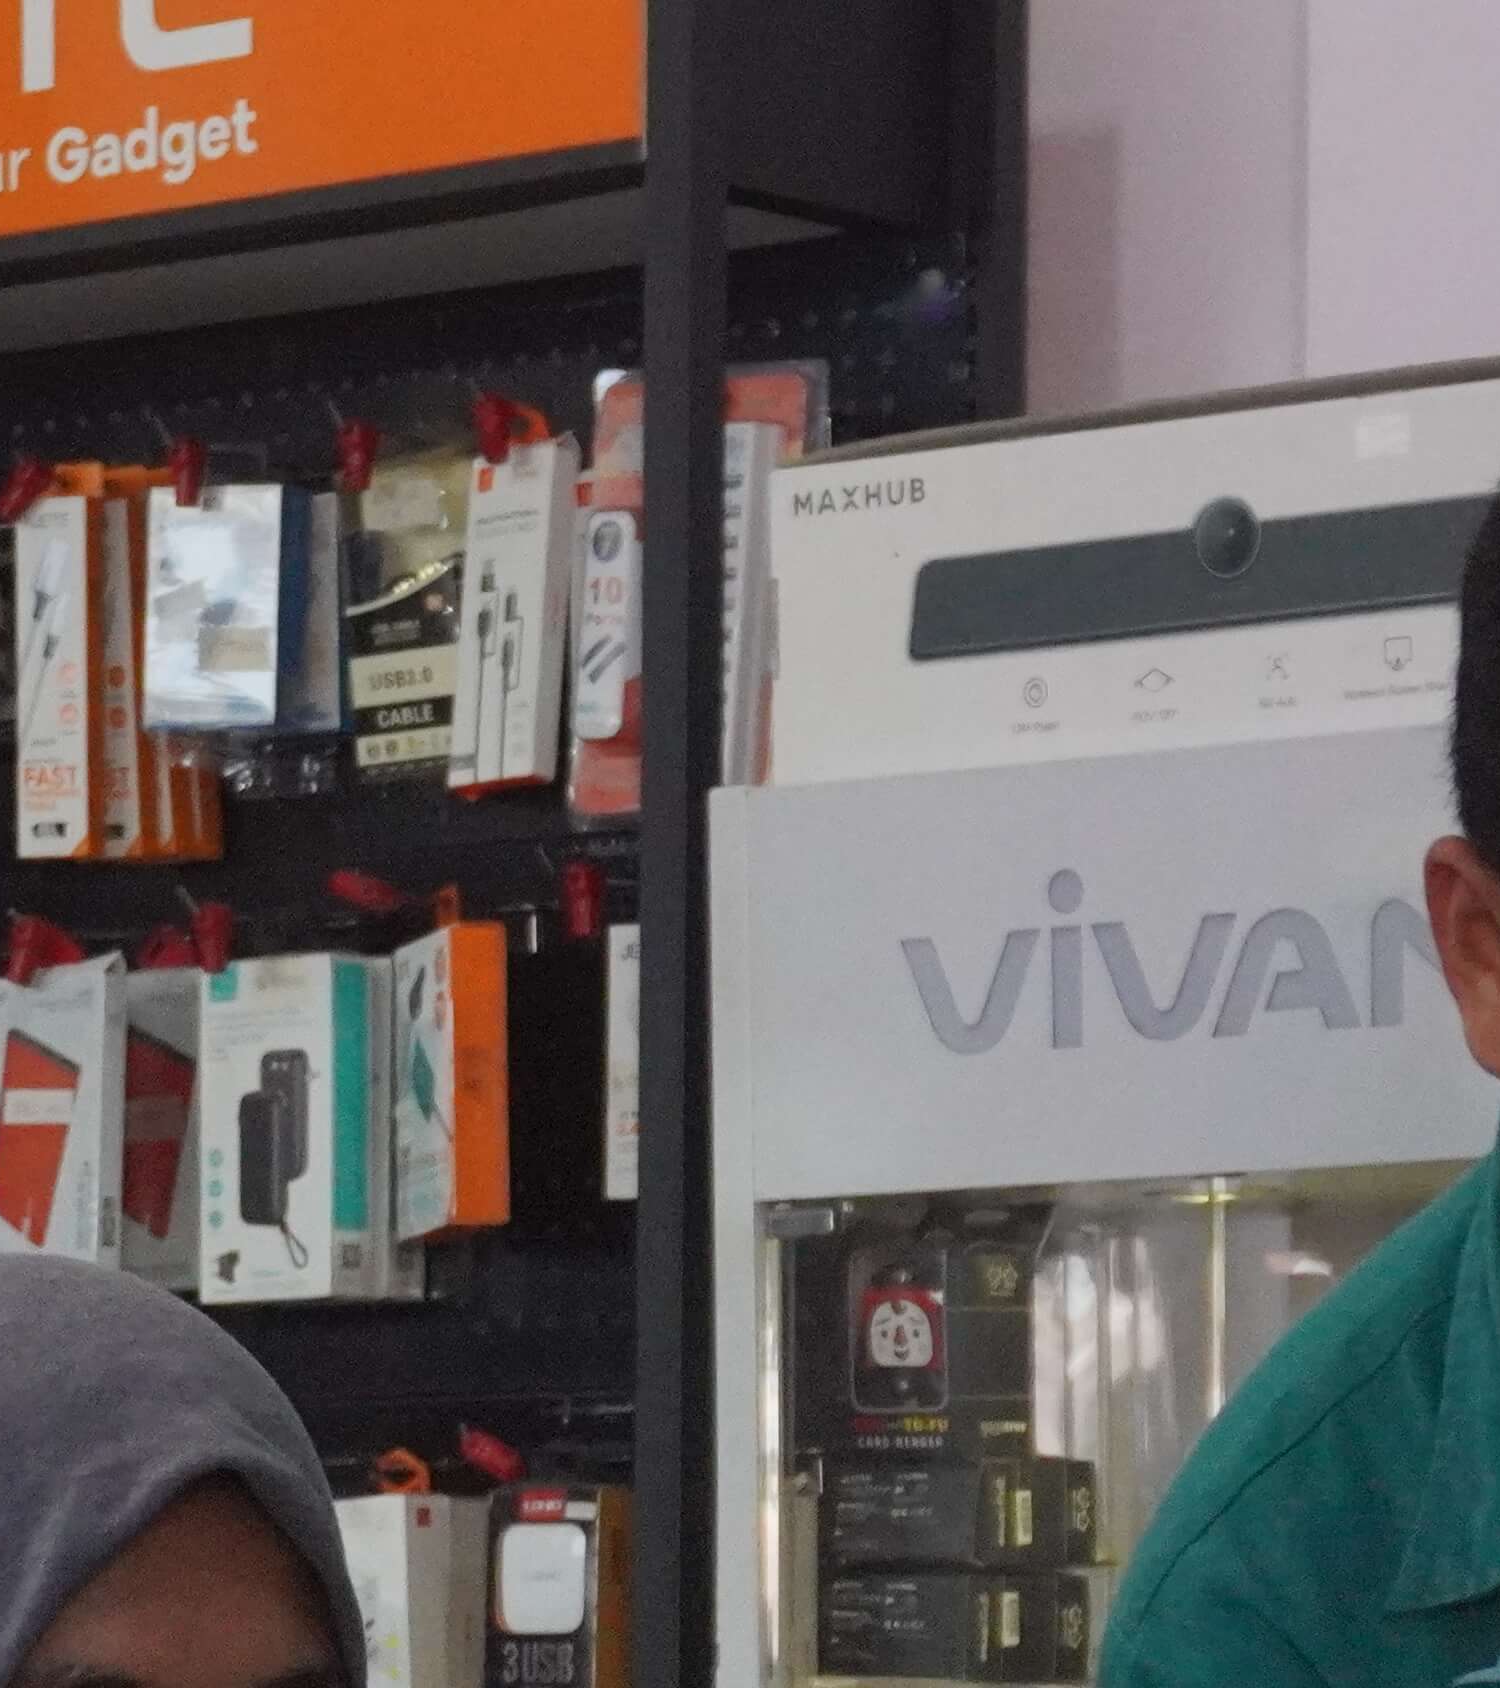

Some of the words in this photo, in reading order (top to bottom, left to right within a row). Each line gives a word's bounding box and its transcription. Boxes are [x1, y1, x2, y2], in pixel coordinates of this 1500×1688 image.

[46, 98, 258, 184] Gadget
[792, 477, 926, 517] MAXHUB
[376, 703, 435, 728] CABLE
